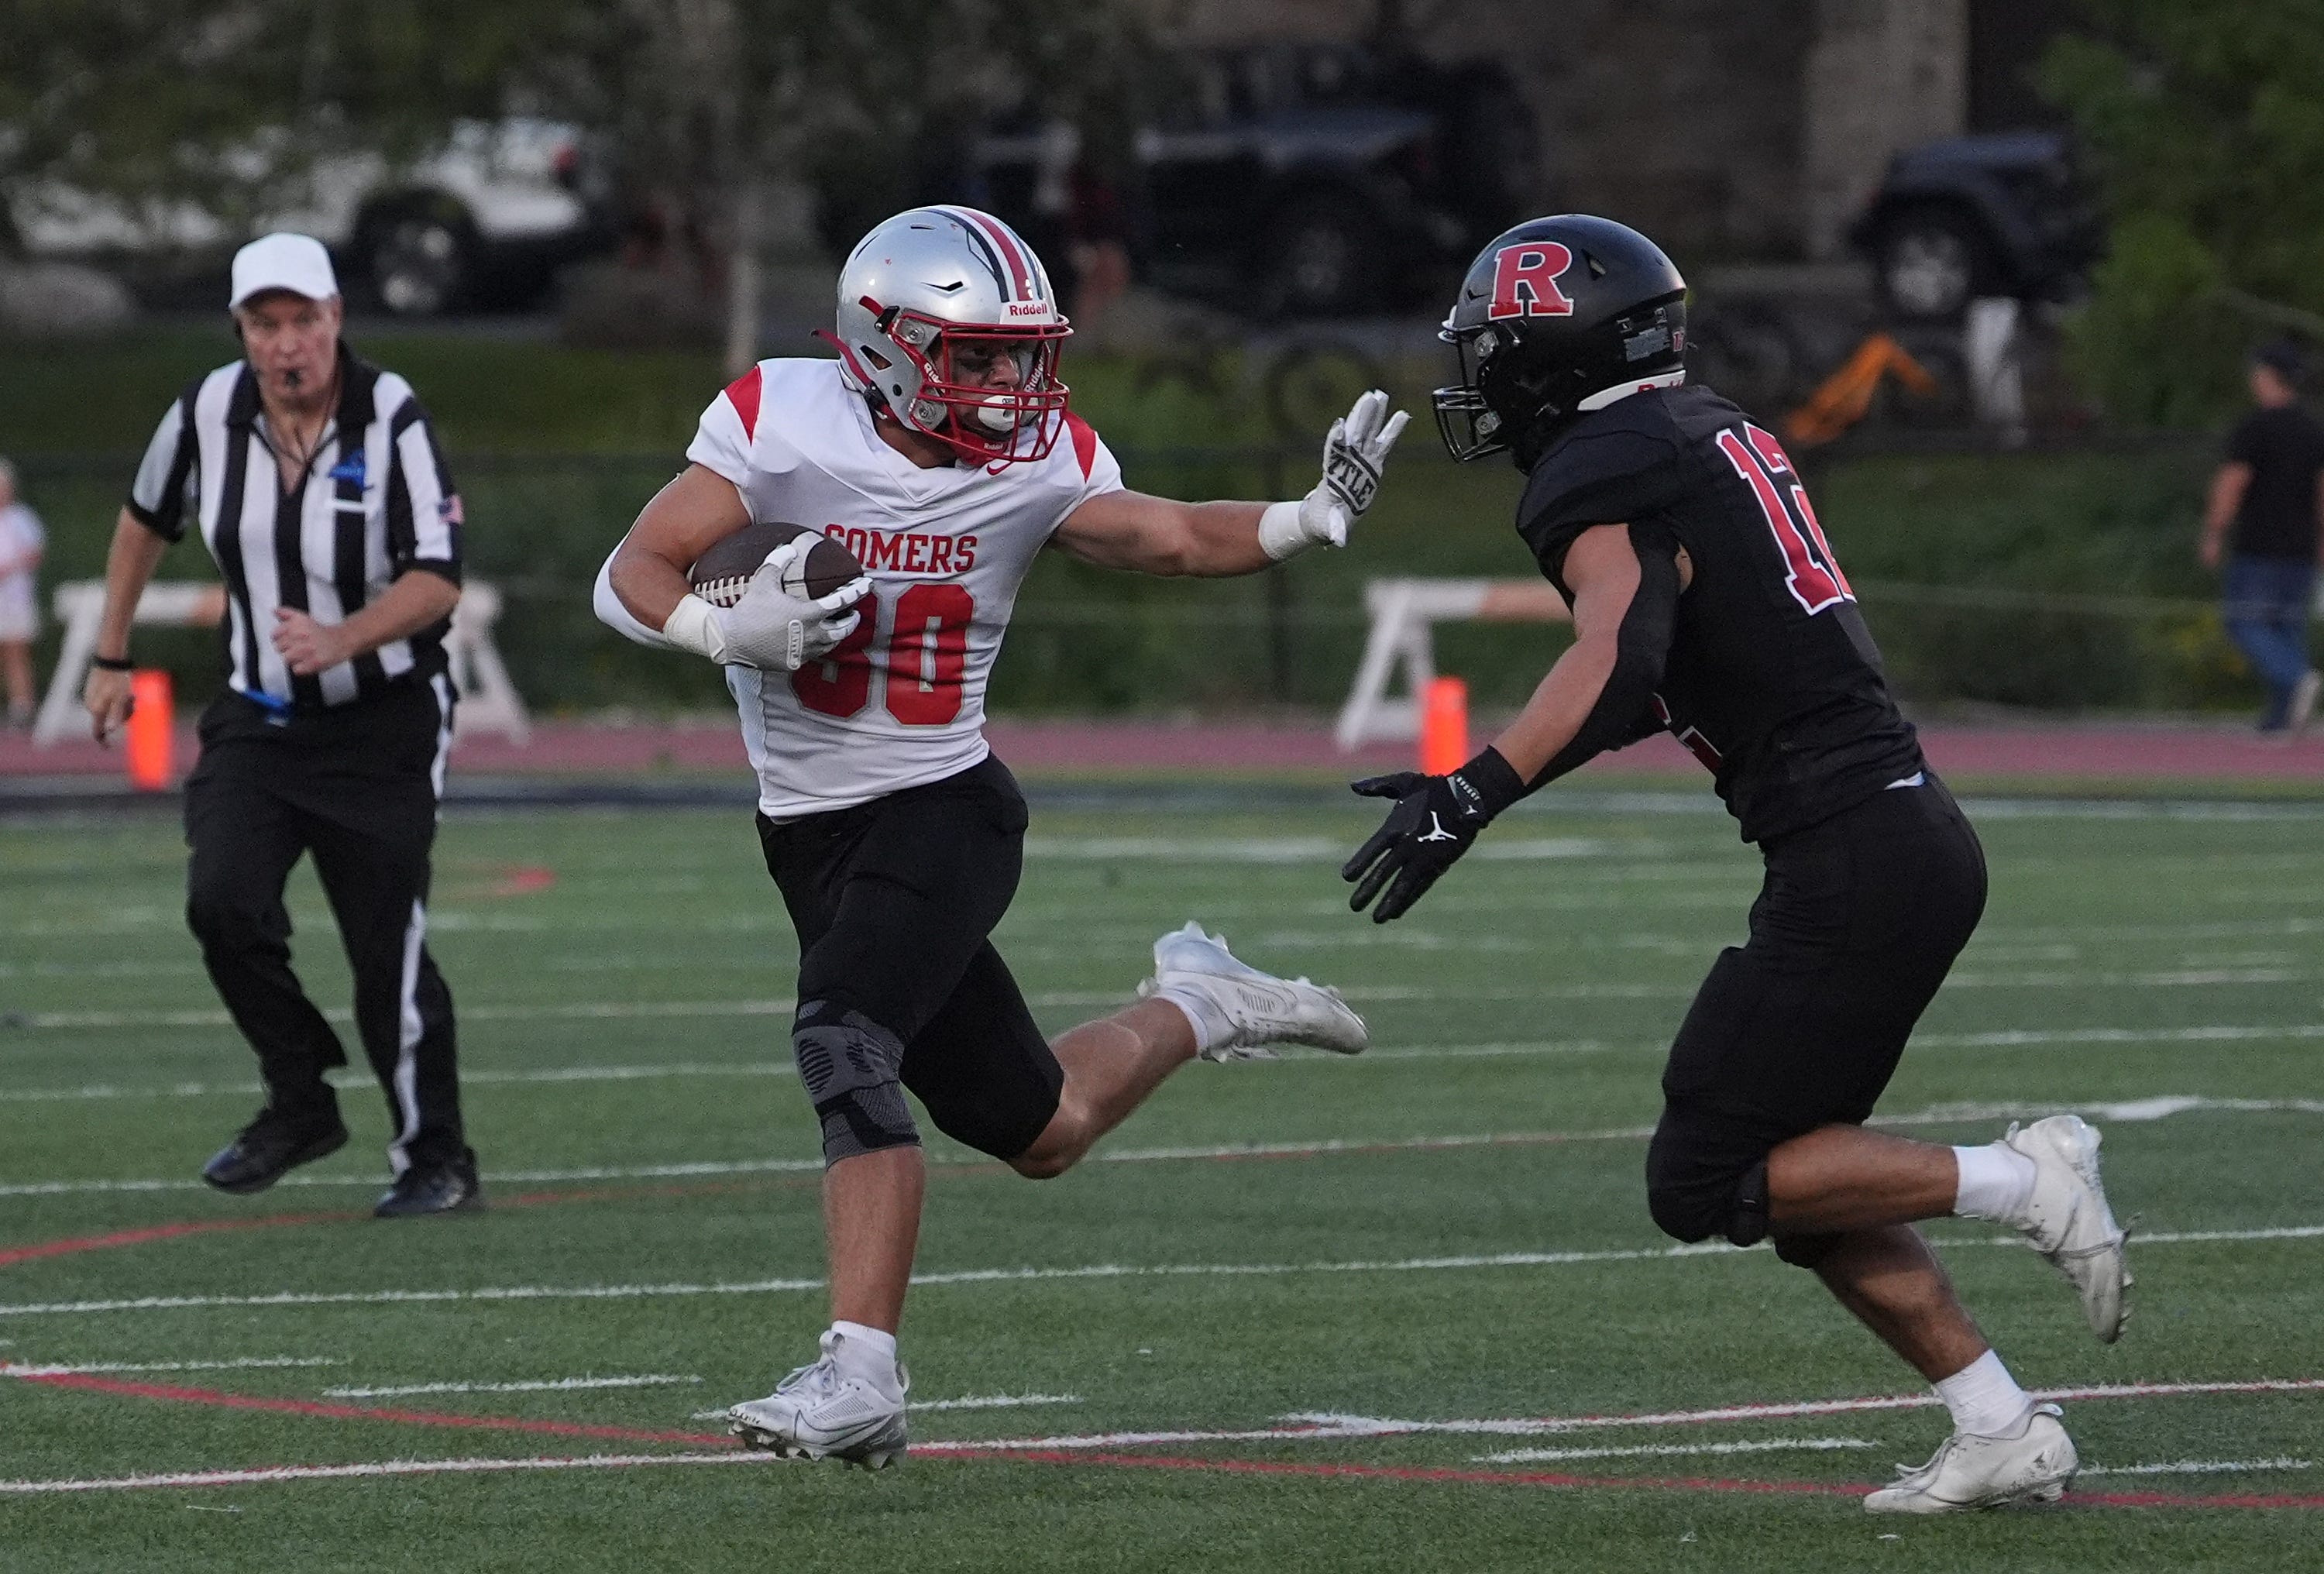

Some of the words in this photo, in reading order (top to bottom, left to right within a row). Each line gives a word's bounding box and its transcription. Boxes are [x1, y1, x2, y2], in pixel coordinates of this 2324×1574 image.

[1009, 303, 1047, 316] Riddell
[1488, 241, 1574, 321] R
[1328, 448, 1377, 507] TTLE
